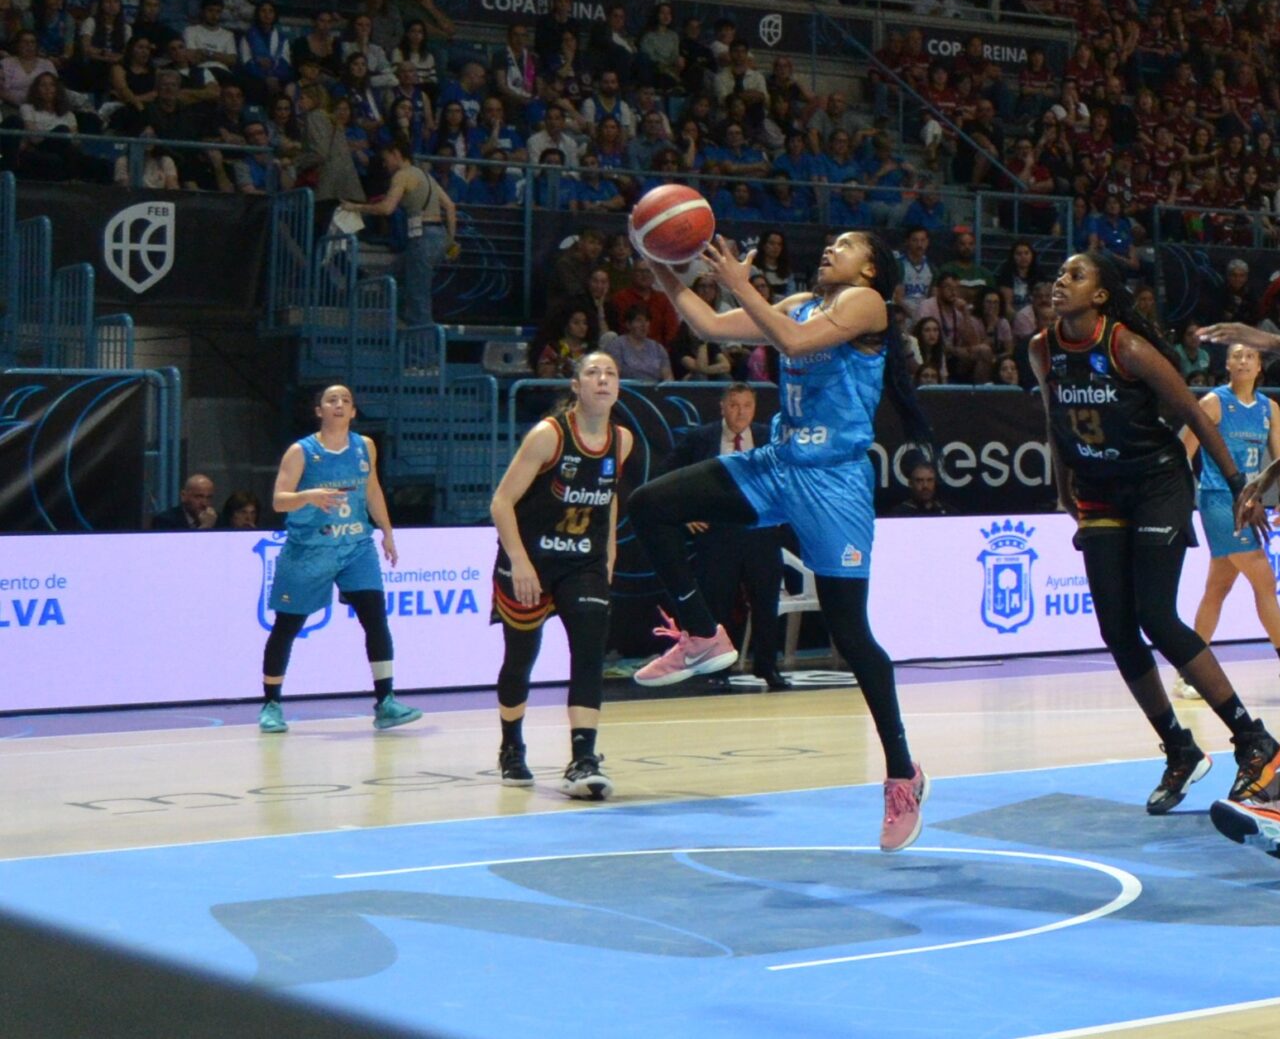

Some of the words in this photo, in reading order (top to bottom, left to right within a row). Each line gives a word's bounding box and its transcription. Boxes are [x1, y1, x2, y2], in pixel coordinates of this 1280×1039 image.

[927, 38, 965, 56] COP
[982, 44, 1029, 64] REINA
[146, 206, 170, 217] FEB
[1057, 384, 1119, 404] lointek
[1068, 408, 1106, 446] 13
[539, 535, 577, 552] bbk
[45, 573, 67, 590] de
[461, 566, 480, 582] de
[348, 589, 479, 618] UELVA
[65, 744, 822, 813] modena
